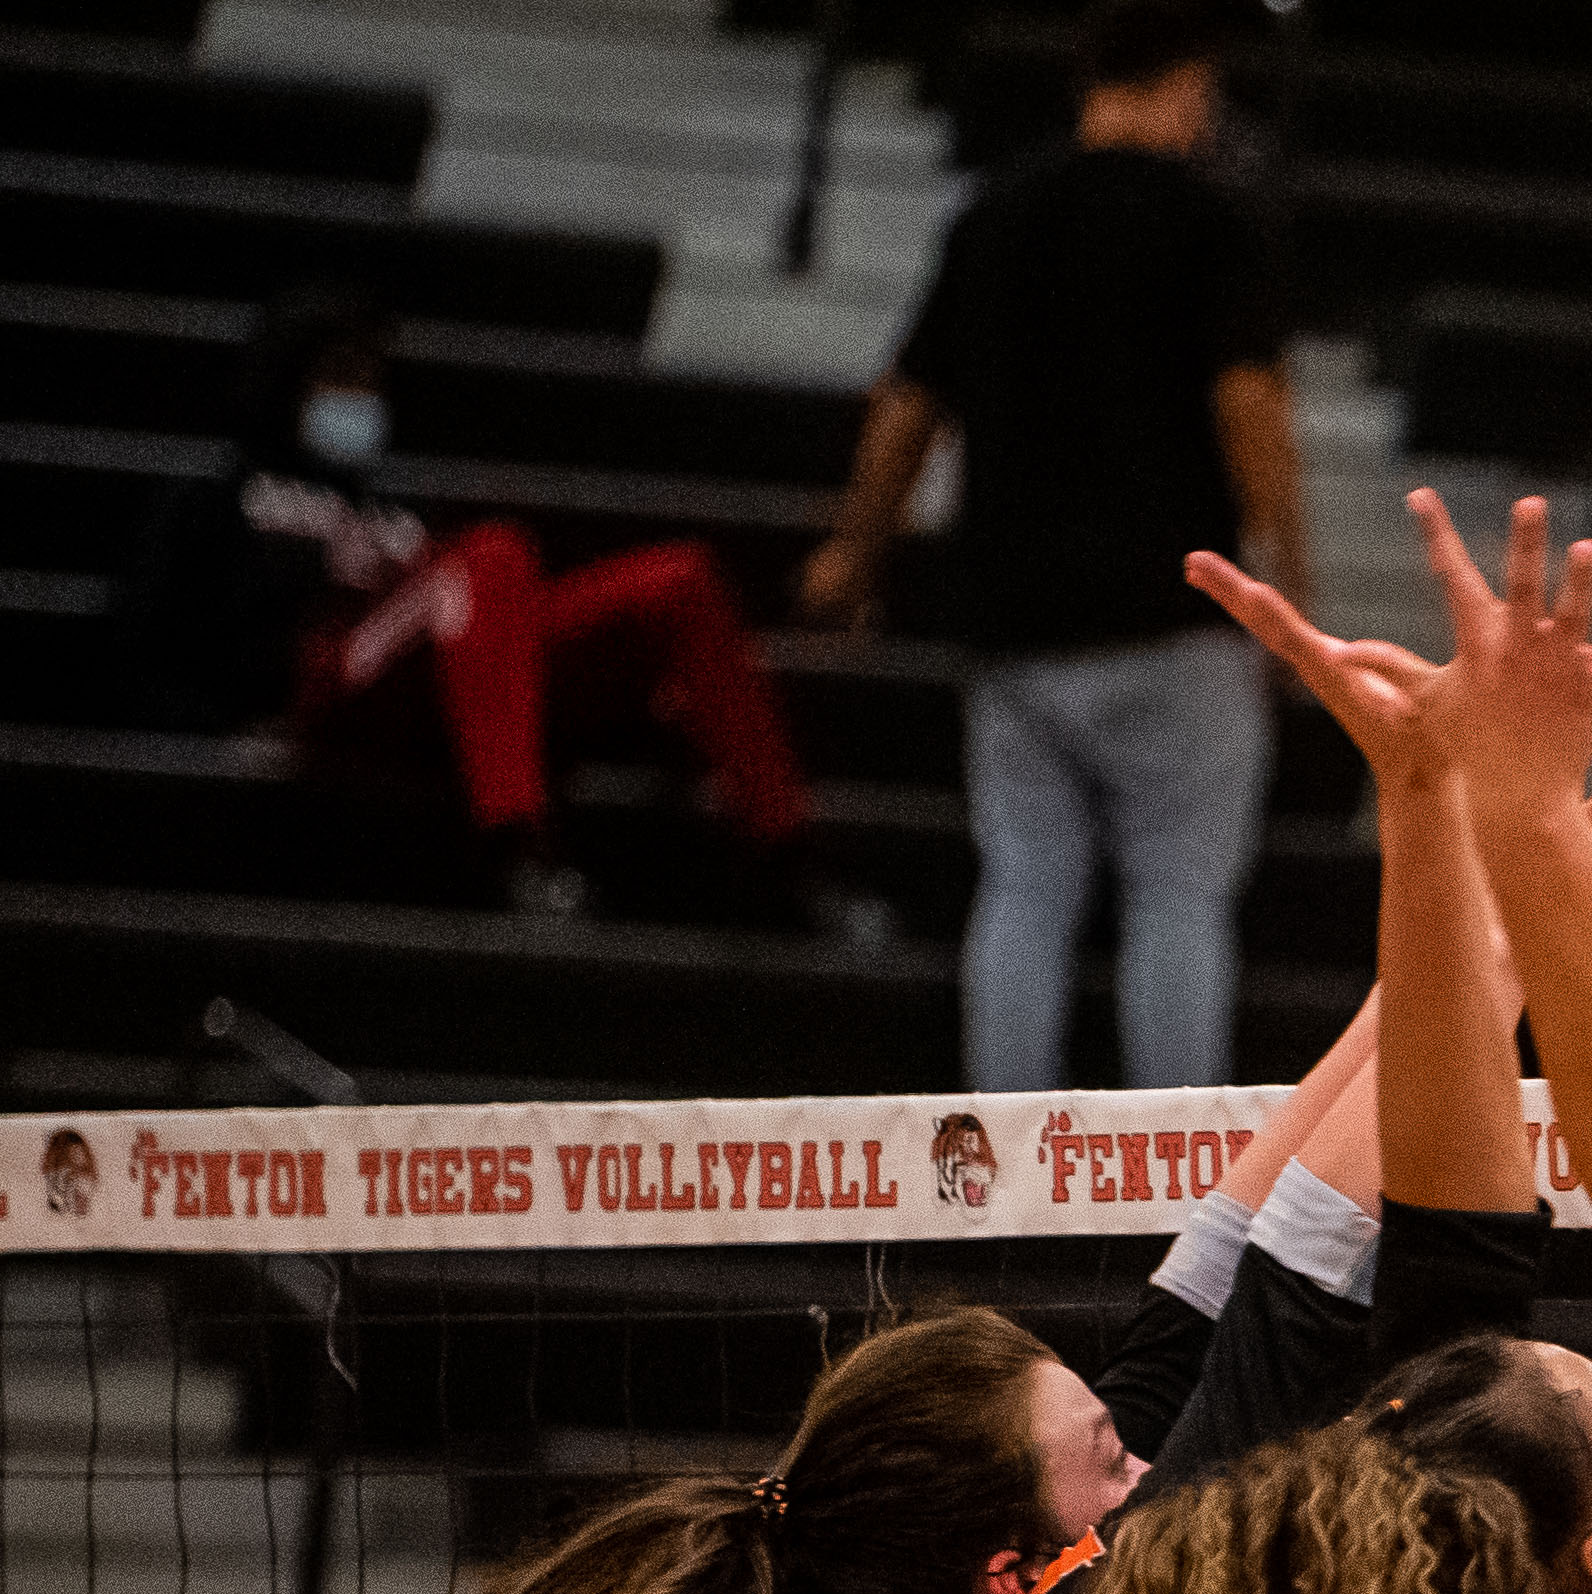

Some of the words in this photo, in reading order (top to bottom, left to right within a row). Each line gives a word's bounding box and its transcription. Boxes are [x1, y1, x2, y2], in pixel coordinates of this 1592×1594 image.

[142, 1150, 327, 1218] FENTON
[358, 1146, 533, 1217] TIGERS
[556, 1140, 898, 1213] VOLLEYBALL
